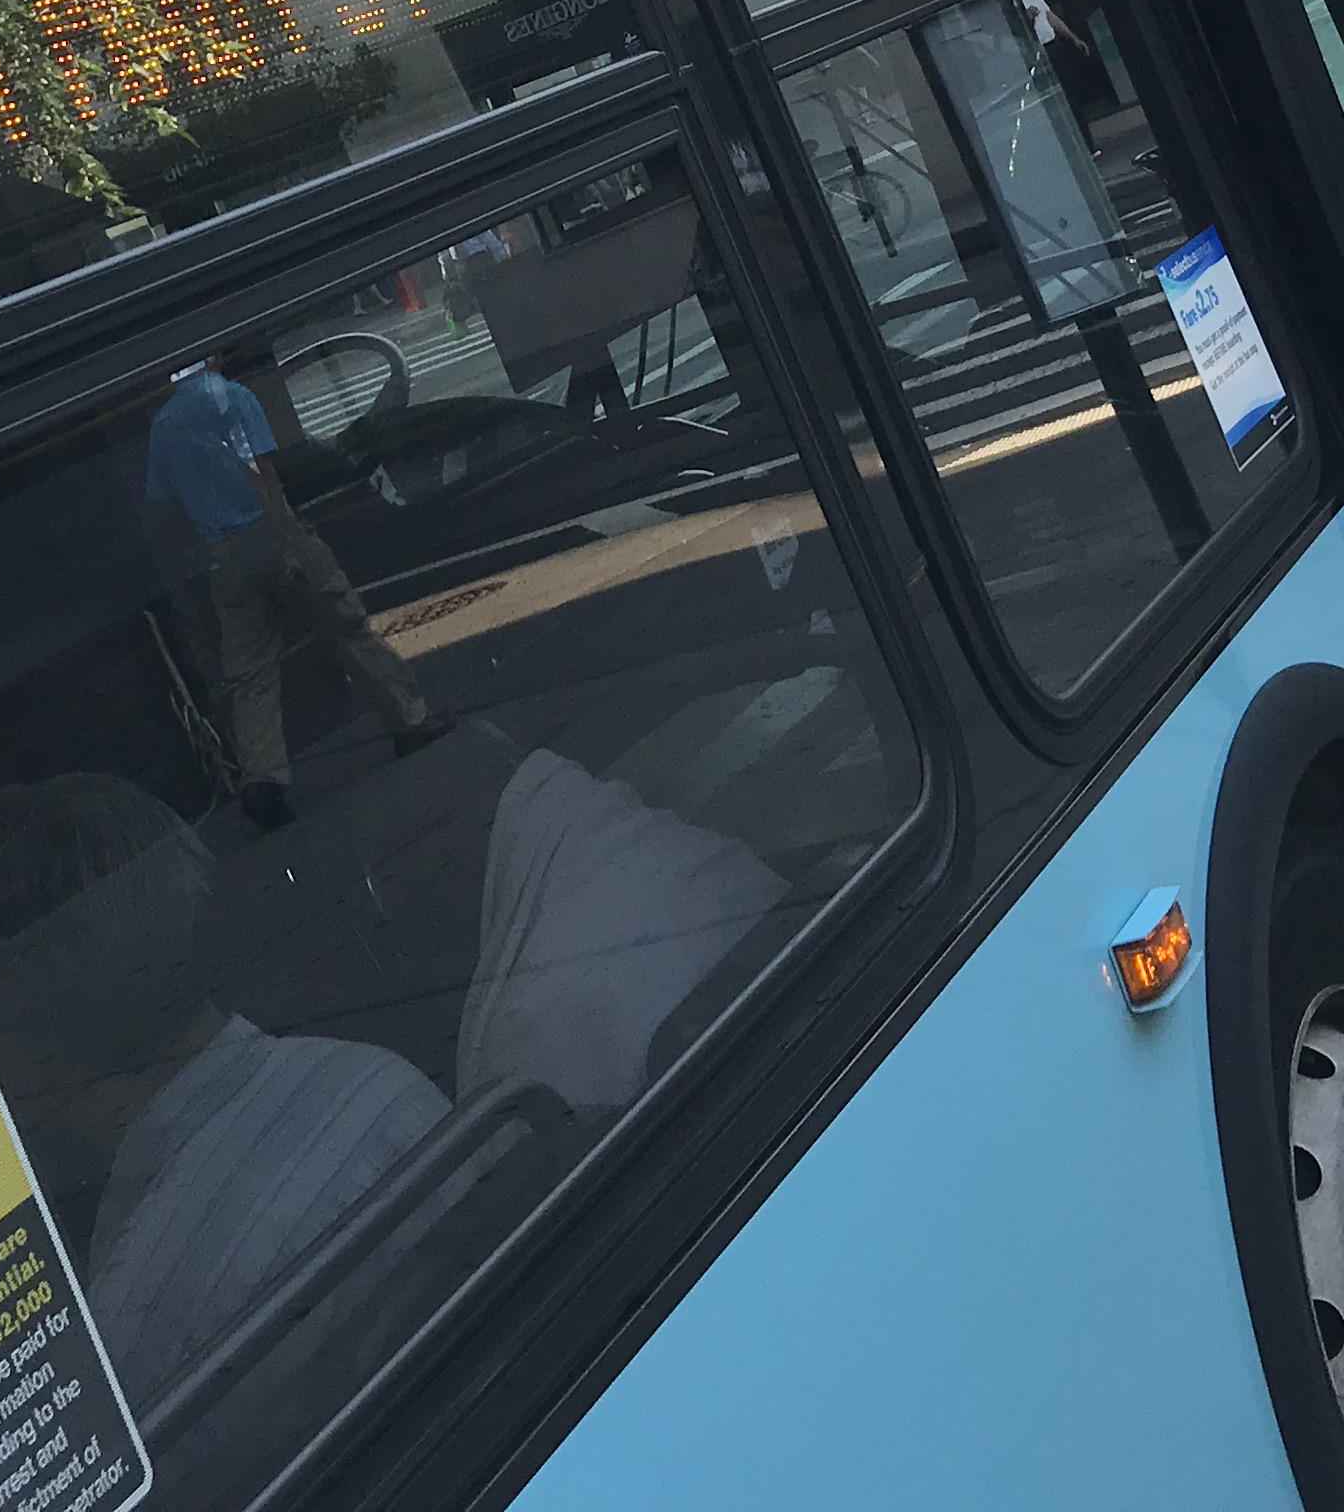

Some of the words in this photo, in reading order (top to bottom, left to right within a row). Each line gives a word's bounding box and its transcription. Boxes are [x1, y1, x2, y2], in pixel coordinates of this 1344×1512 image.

[10, 1322, 47, 1373] paid
[45, 1306, 70, 1337] for
[33, 1403, 55, 1427] to
[52, 1378, 82, 1411] the
[35, 1425, 69, 1469] and
[84, 1434, 102, 1466] of
